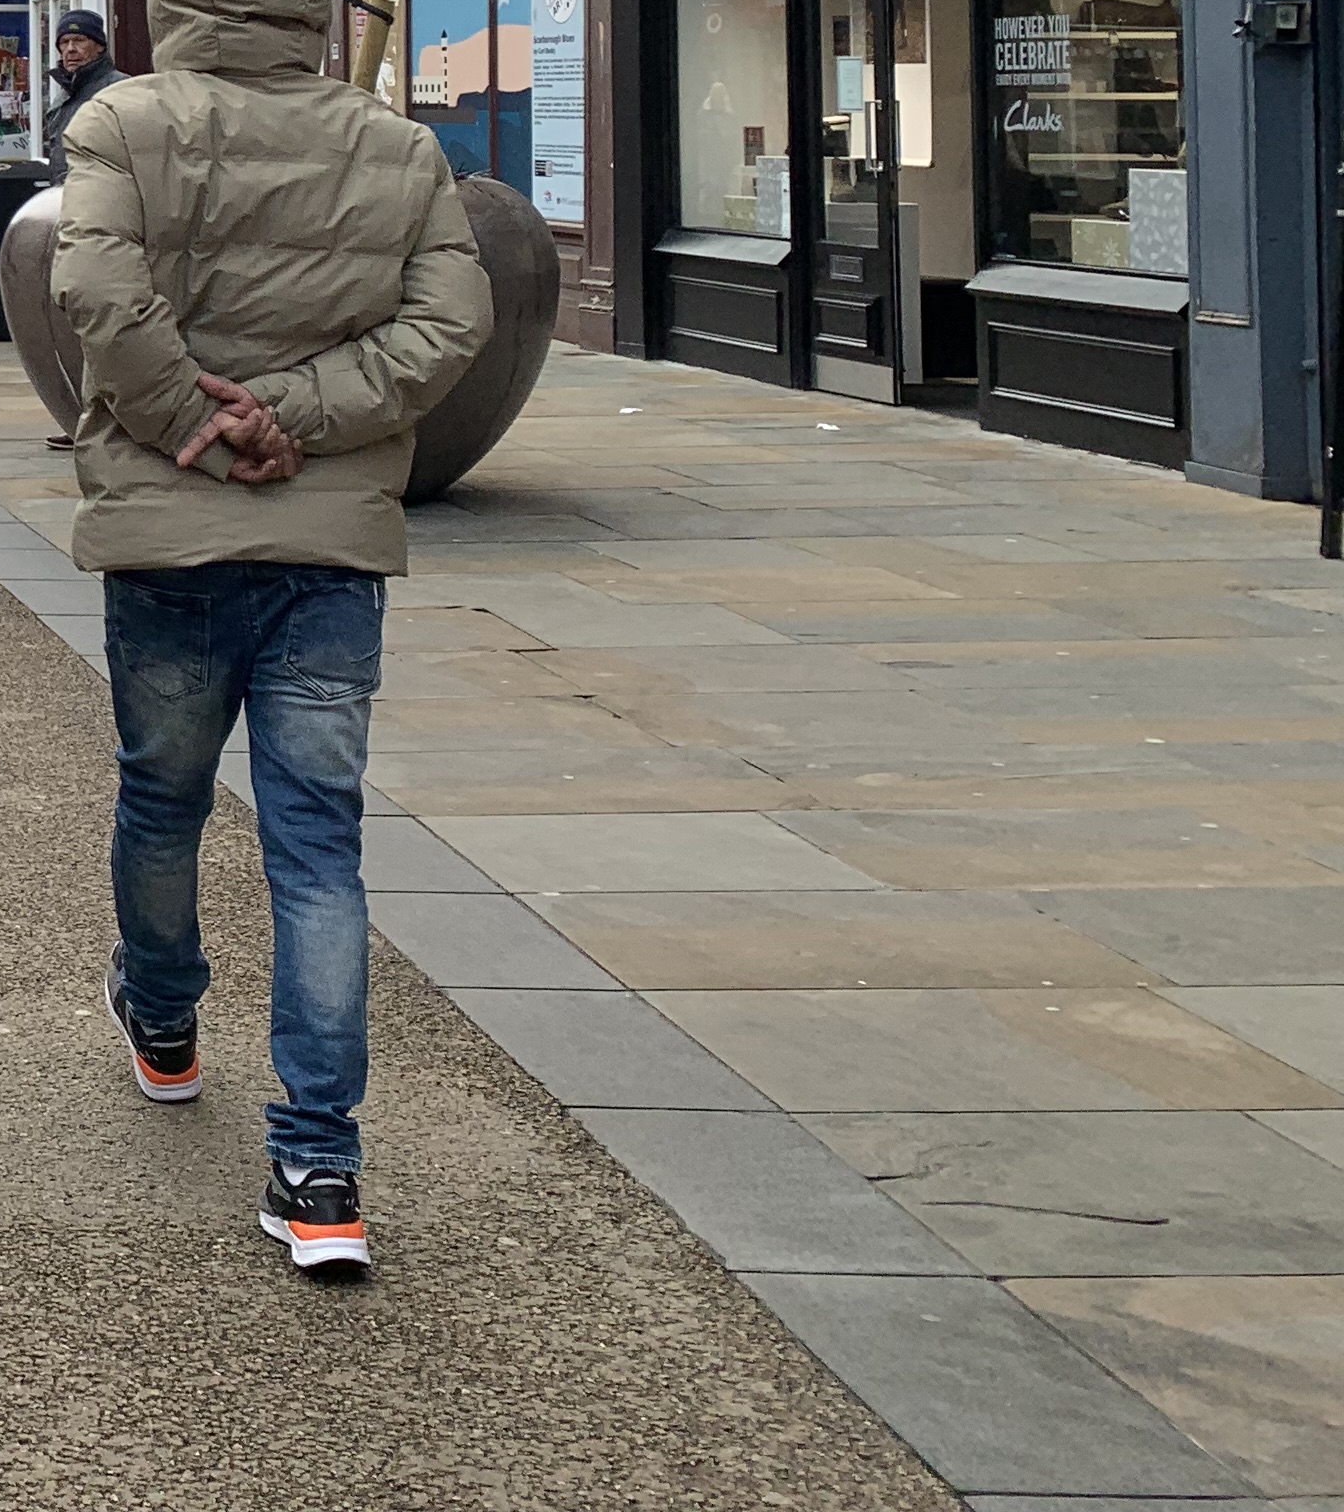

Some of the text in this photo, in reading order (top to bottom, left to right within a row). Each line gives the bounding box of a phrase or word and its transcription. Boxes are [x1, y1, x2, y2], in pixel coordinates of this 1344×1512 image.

[994, 14, 1070, 39] HOWEVER YOU
[995, 40, 1071, 70] CELEBRATE
[1004, 99, 1064, 132] Clarks
